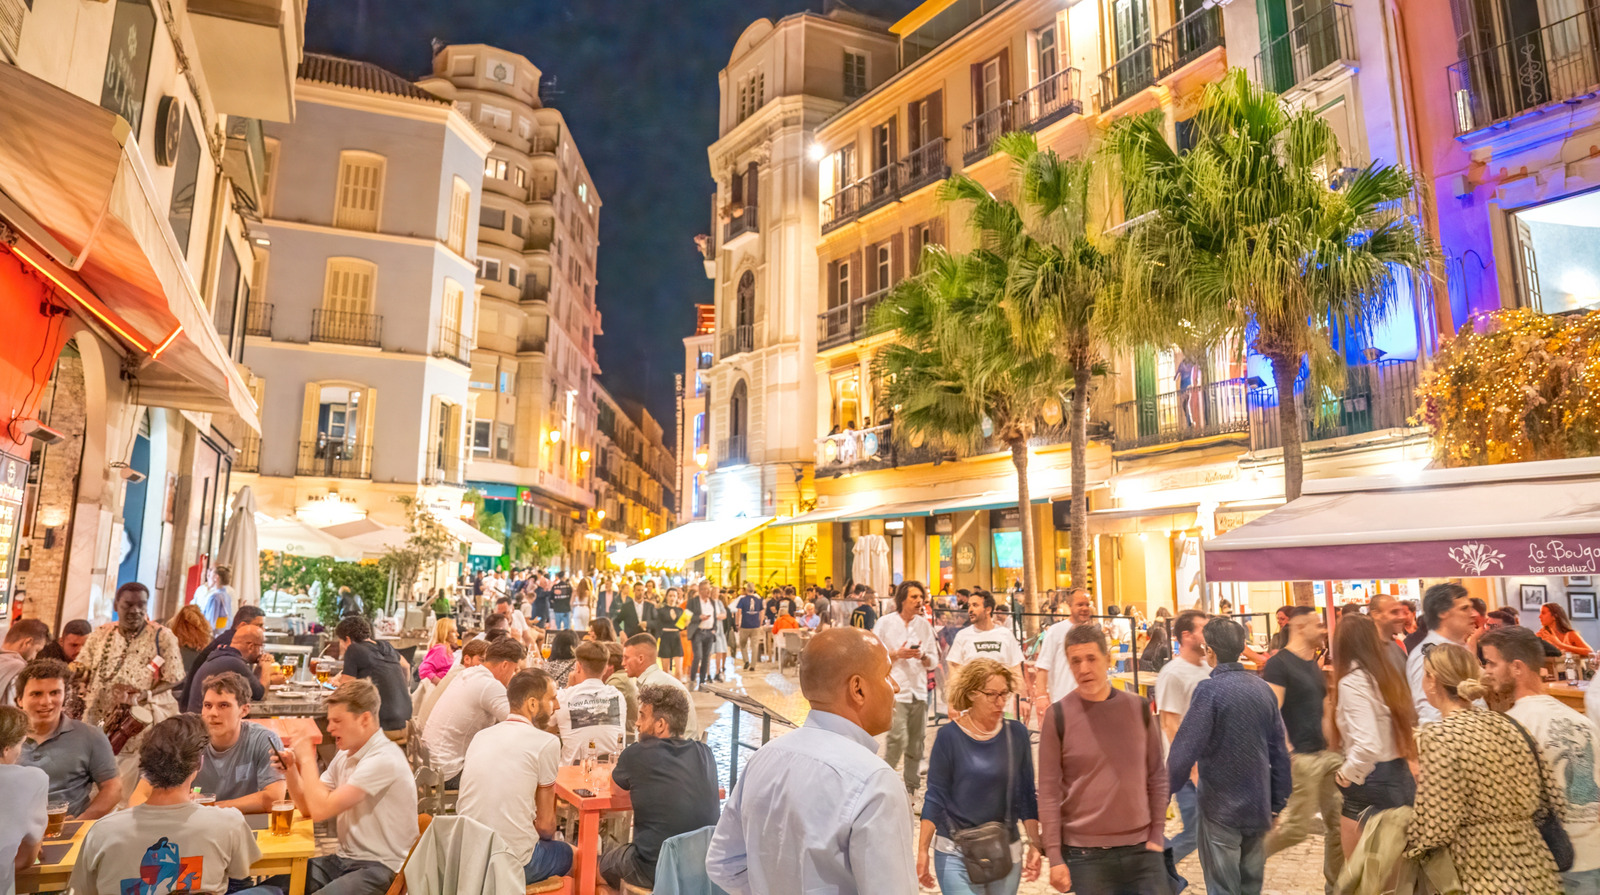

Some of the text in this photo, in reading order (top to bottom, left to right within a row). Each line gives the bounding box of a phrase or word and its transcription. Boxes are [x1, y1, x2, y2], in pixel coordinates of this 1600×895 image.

[1528, 543, 1547, 563] La
[1529, 564, 1588, 573] bar andaluz
